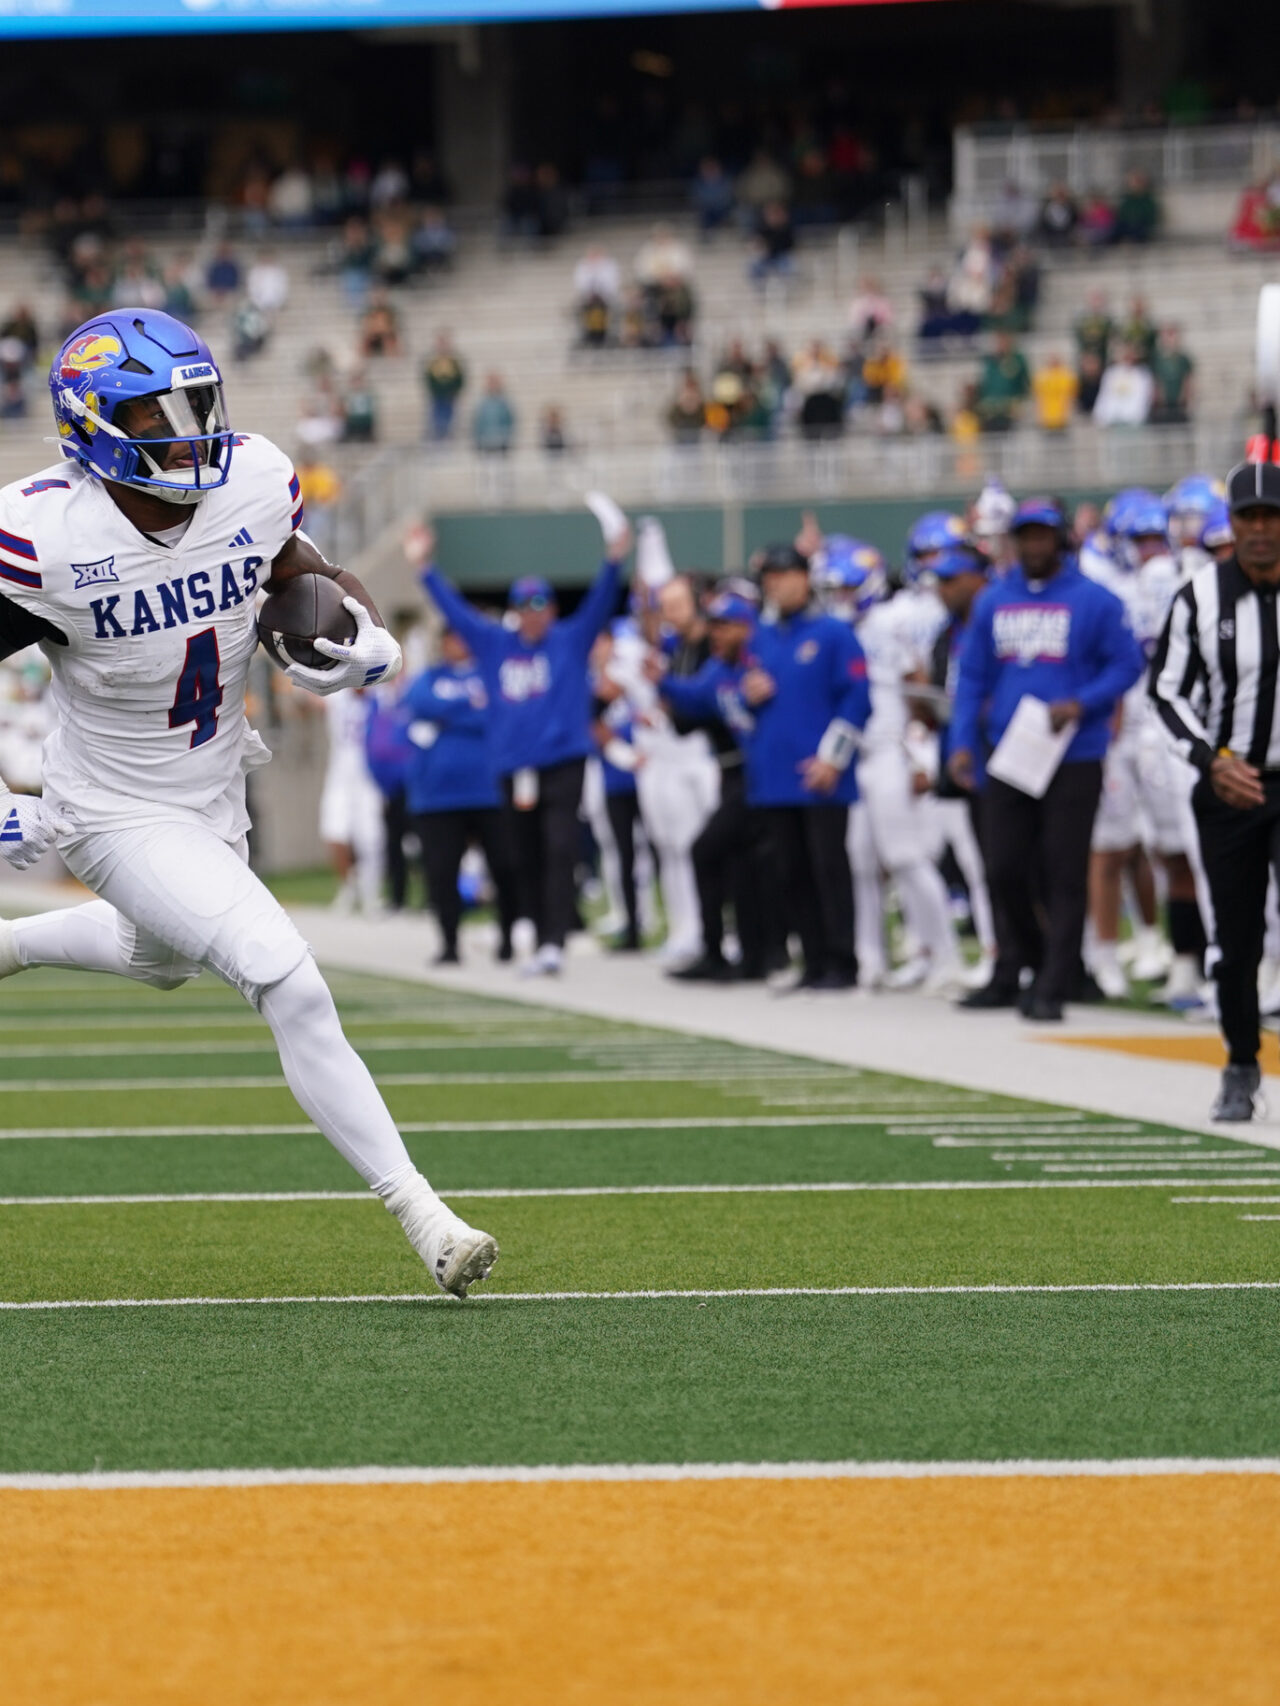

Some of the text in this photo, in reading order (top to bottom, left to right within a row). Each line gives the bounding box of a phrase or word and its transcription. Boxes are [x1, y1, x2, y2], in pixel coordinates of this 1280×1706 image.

[180, 365, 213, 380] KANSAS
[21, 479, 71, 497] 4
[89, 556, 264, 639] KANSAS
[168, 626, 225, 750] 4
